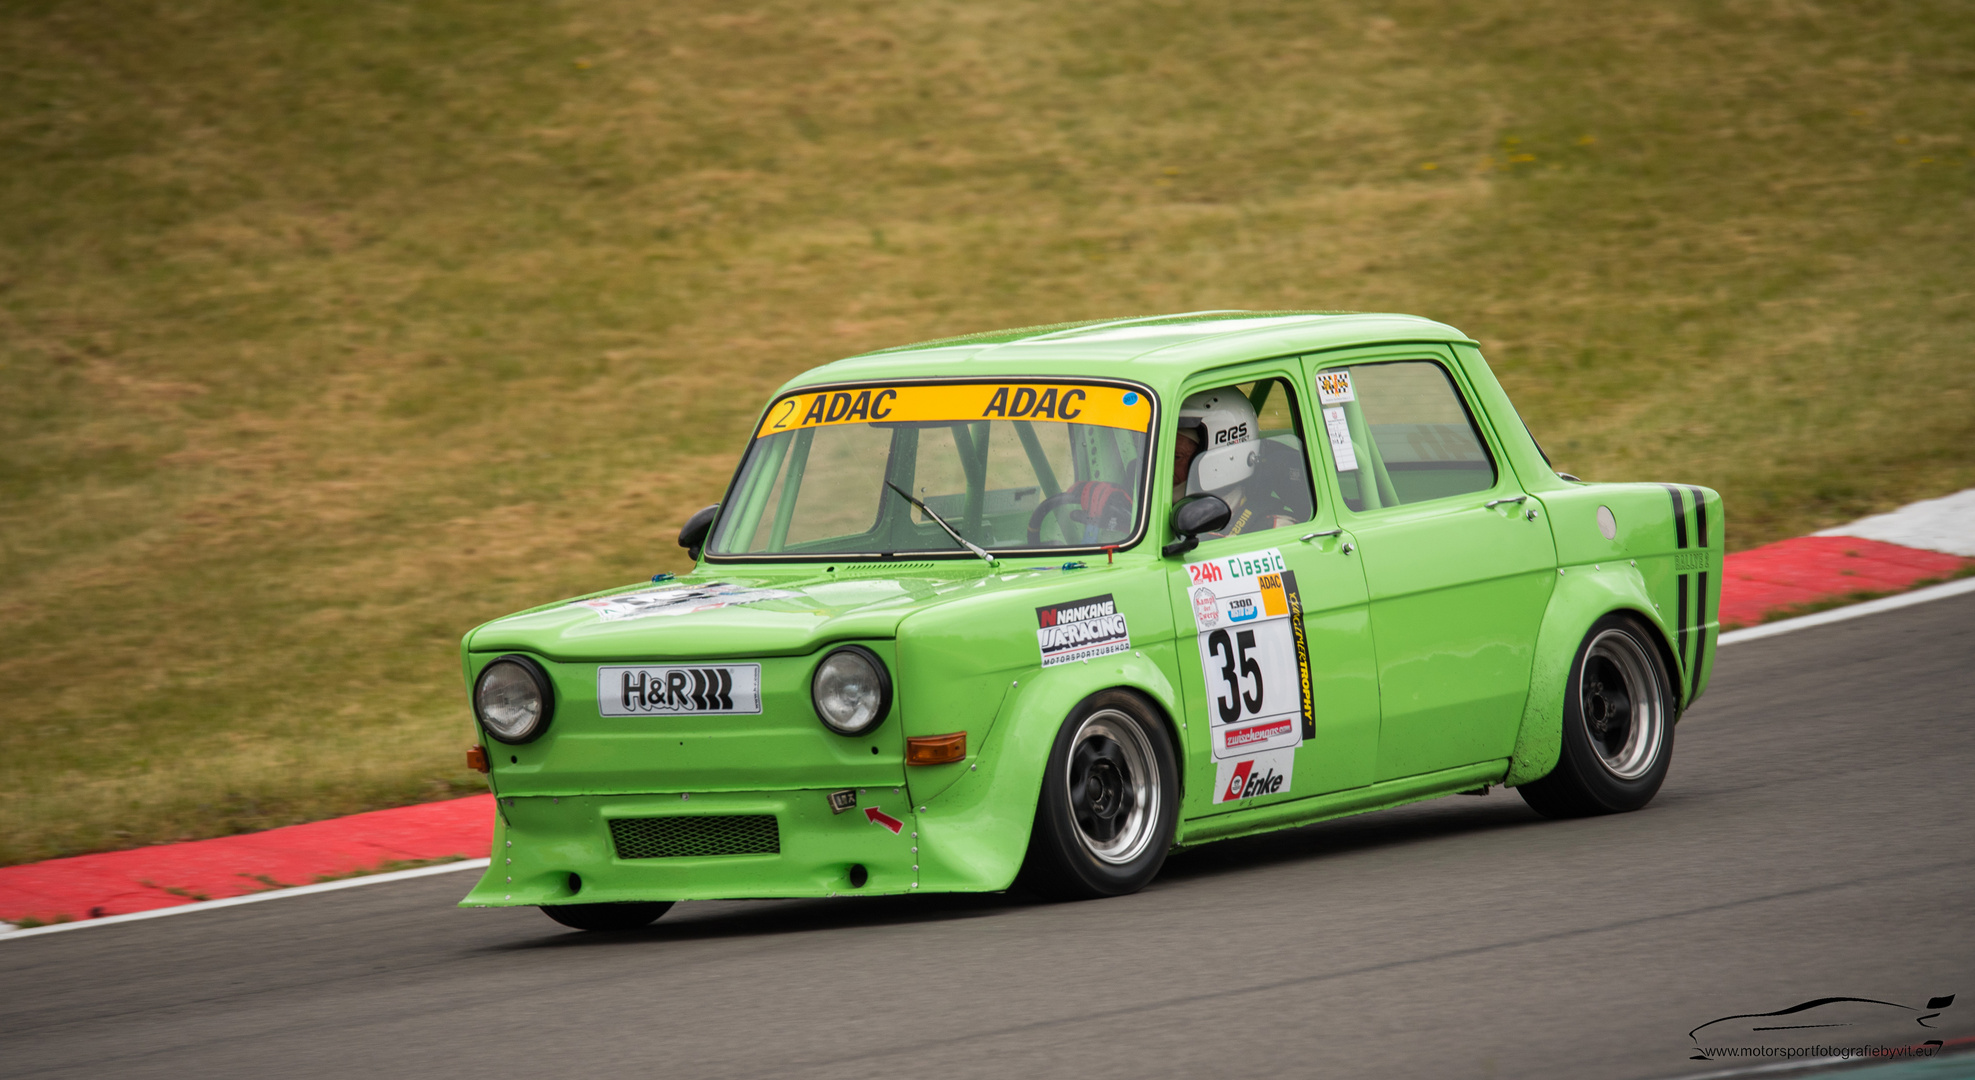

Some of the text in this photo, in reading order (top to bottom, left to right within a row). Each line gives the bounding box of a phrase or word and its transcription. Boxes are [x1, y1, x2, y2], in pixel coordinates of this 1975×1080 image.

[774, 400, 795, 428] 2
[801, 389, 897, 425] ADAC
[982, 388, 1086, 420] ADAC
[1215, 422, 1247, 445] RRS
[1190, 552, 1283, 583] 24h Classic
[1260, 575, 1281, 590] ADAC
[1057, 600, 1114, 625] NANKANG
[1229, 598, 1252, 609] 1300
[621, 670, 694, 711] H&R
[1208, 628, 1264, 723] 35
[1242, 768, 1283, 798] Enke
